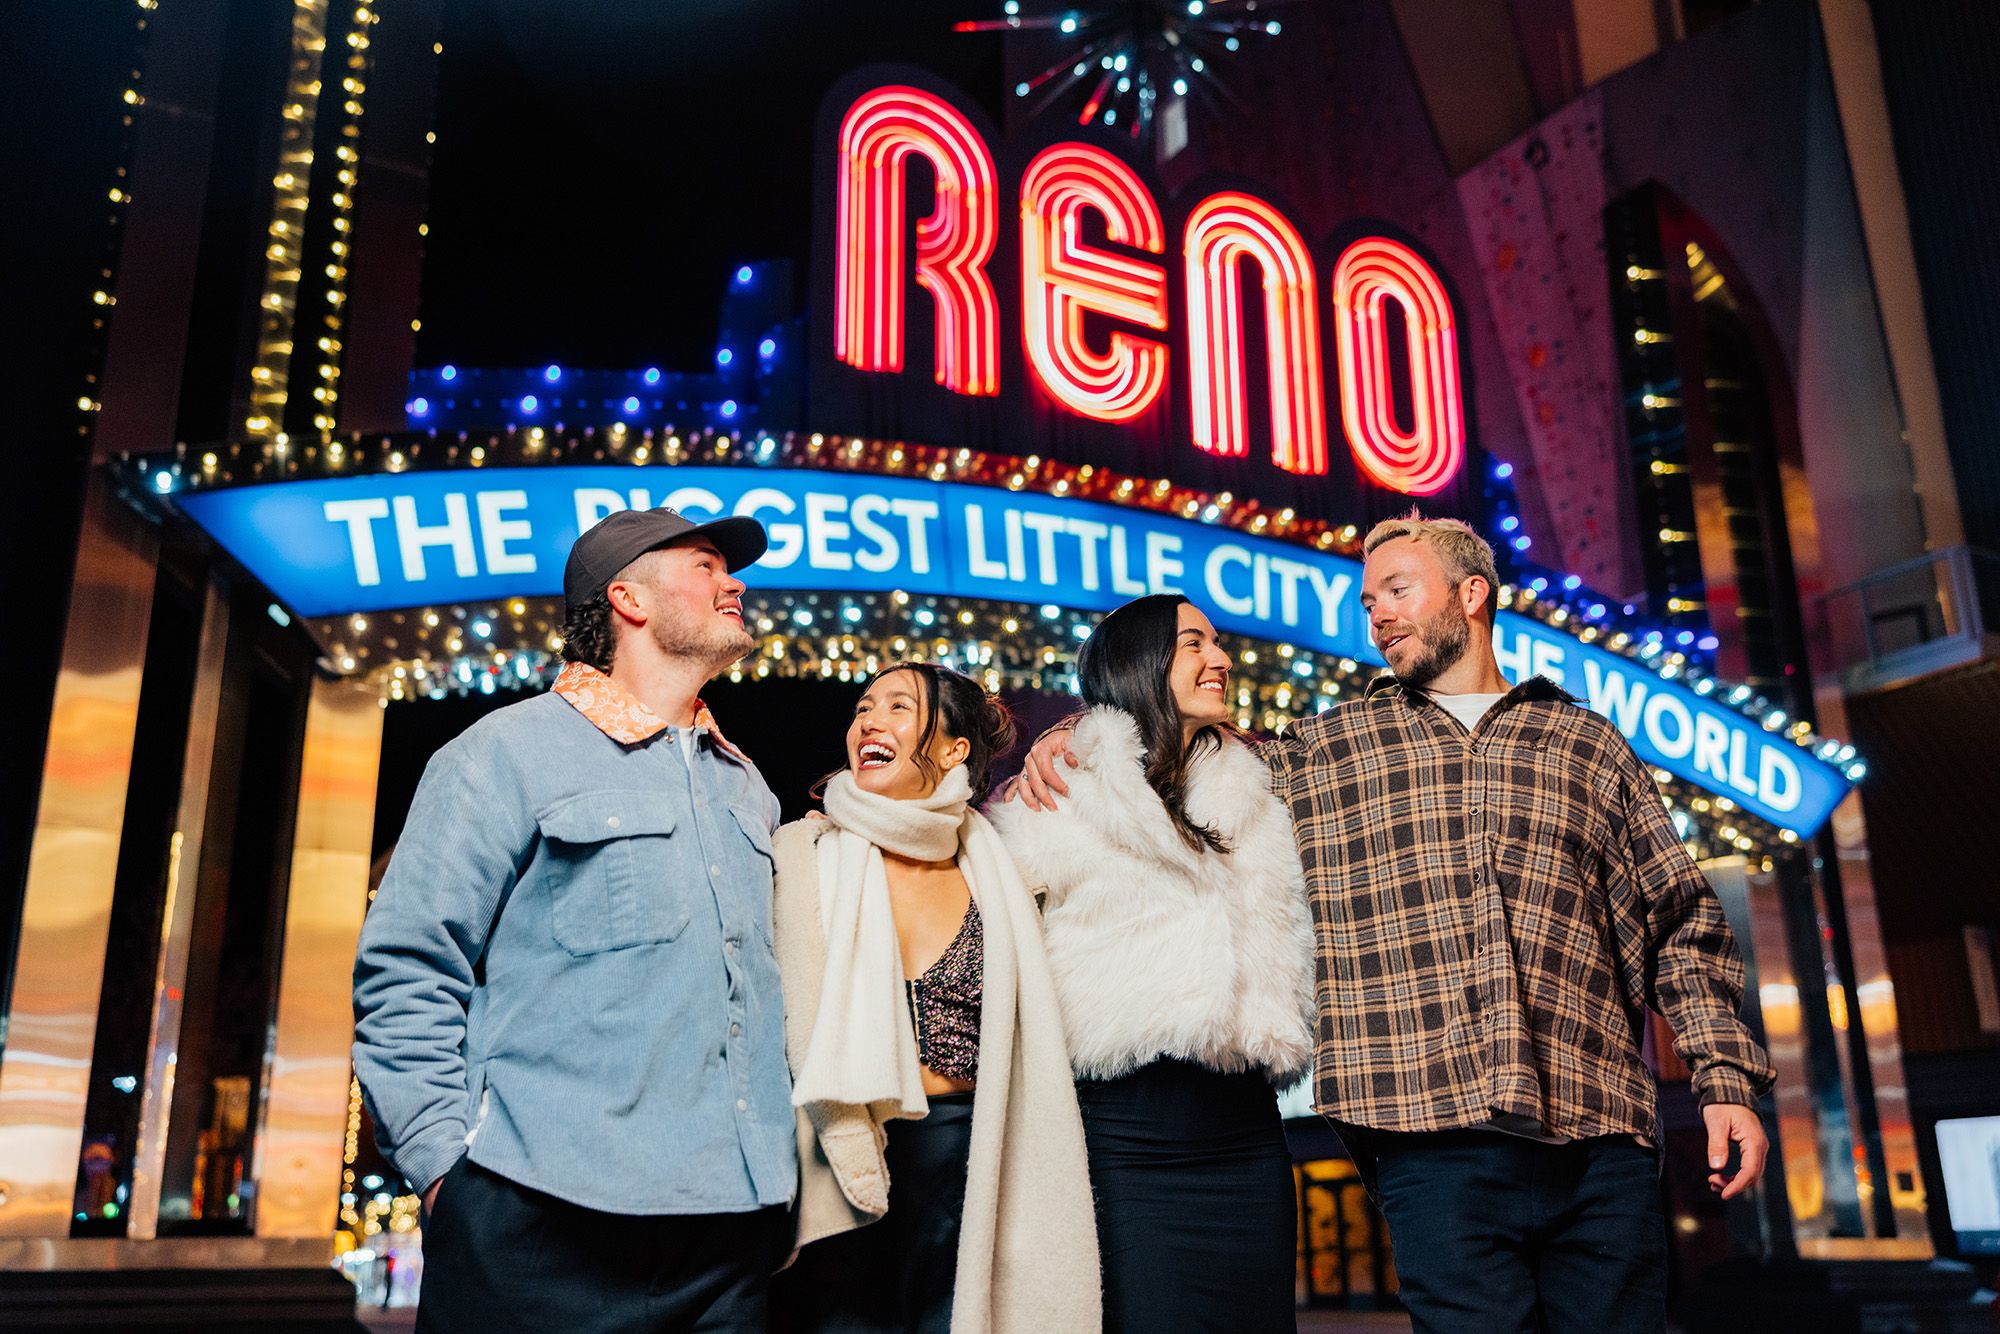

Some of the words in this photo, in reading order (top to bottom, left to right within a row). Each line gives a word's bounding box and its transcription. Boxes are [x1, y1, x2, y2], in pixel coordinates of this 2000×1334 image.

[323, 489, 538, 587] THE
[573, 486, 940, 575] GEST
[964, 503, 1187, 599] LITTLE
[1203, 544, 1353, 638] CITY
[1490, 622, 1566, 688] HE
[1582, 658, 1803, 813] WORLD
